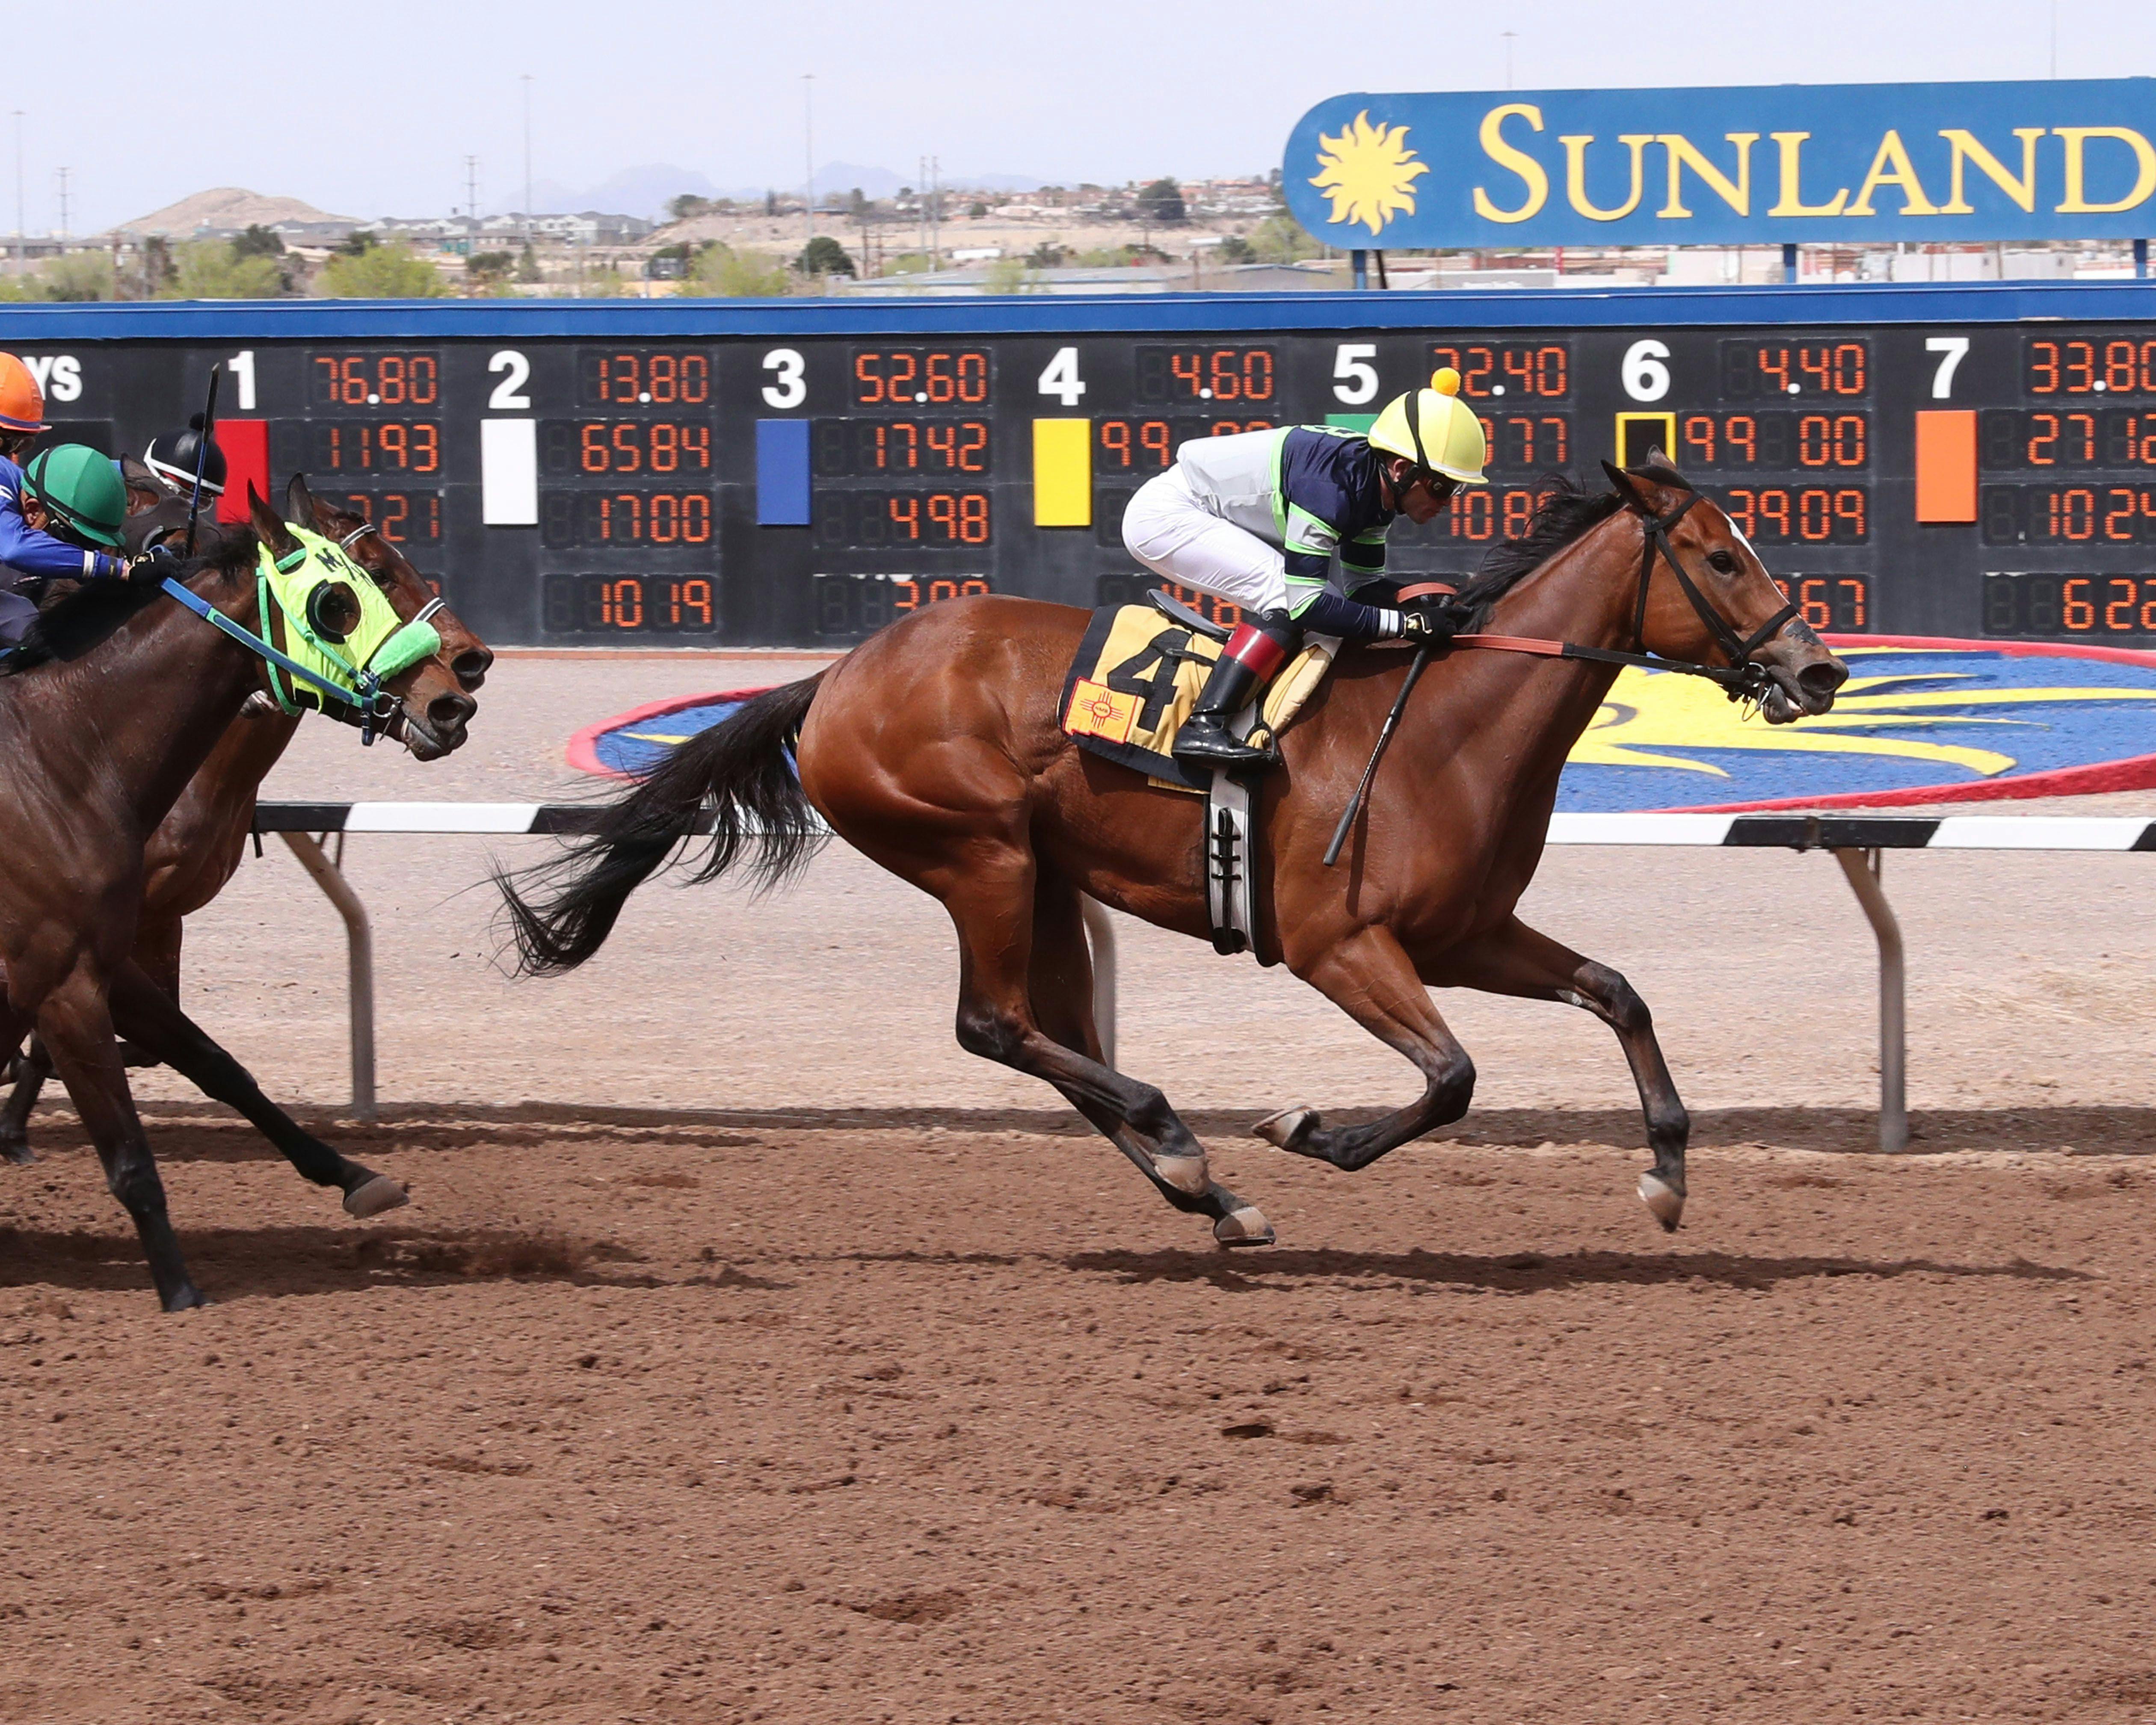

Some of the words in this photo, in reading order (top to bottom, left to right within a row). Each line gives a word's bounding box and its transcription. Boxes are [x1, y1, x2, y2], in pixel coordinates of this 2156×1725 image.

[228, 351, 256, 409] 1
[315, 357, 437, 404] 76.80
[489, 350, 531, 409] 2
[600, 355, 708, 403] 13.80
[761, 349, 807, 409] 3
[856, 354, 986, 402] 52.60
[1038, 347, 1086, 406] 4
[1172, 351, 1273, 400] 4.60
[1333, 344, 1379, 405] 5
[1621, 339, 1670, 402] 6
[1759, 344, 1865, 394] 4.40
[1925, 337, 1969, 399] 7
[332, 424, 438, 471] 1193
[582, 424, 710, 471] 6584
[876, 423, 987, 471] 1742
[1685, 416, 1756, 462] 99
[1800, 416, 1865, 466] 00
[601, 495, 710, 542] 1700
[890, 495, 989, 543] 498
[1729, 490, 1865, 539] 3909
[602, 580, 711, 627] 1019
[1774, 579, 1865, 630] 67
[1107, 628, 1194, 732] 4
